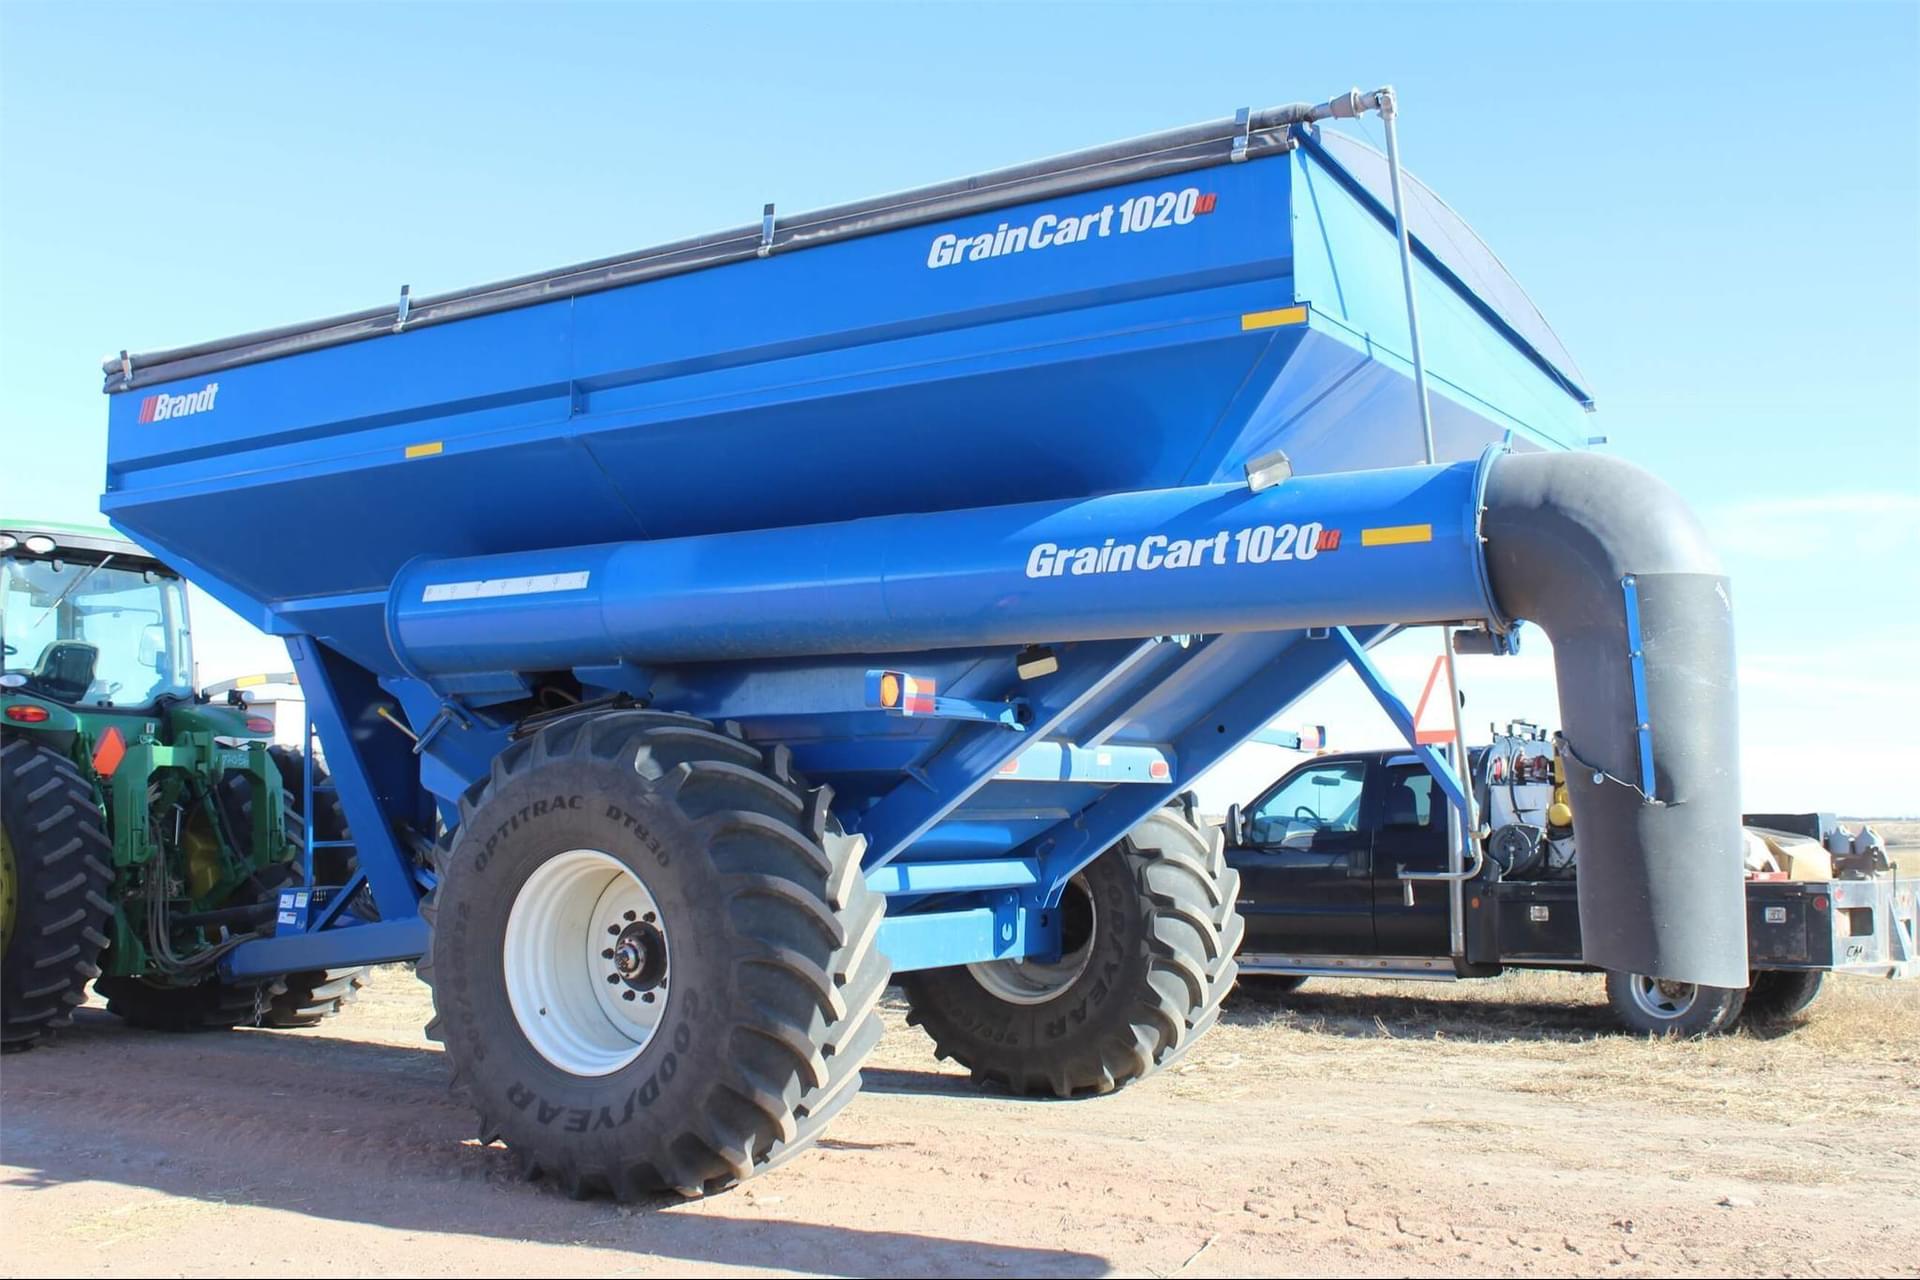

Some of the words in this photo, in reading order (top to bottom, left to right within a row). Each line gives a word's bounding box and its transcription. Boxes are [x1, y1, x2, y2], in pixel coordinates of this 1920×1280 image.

[153, 383, 219, 422] Brandt
[474, 795, 585, 873] OPTITRAC
[606, 804, 670, 868] DT830
[507, 986, 698, 1133] GOODYEAR
